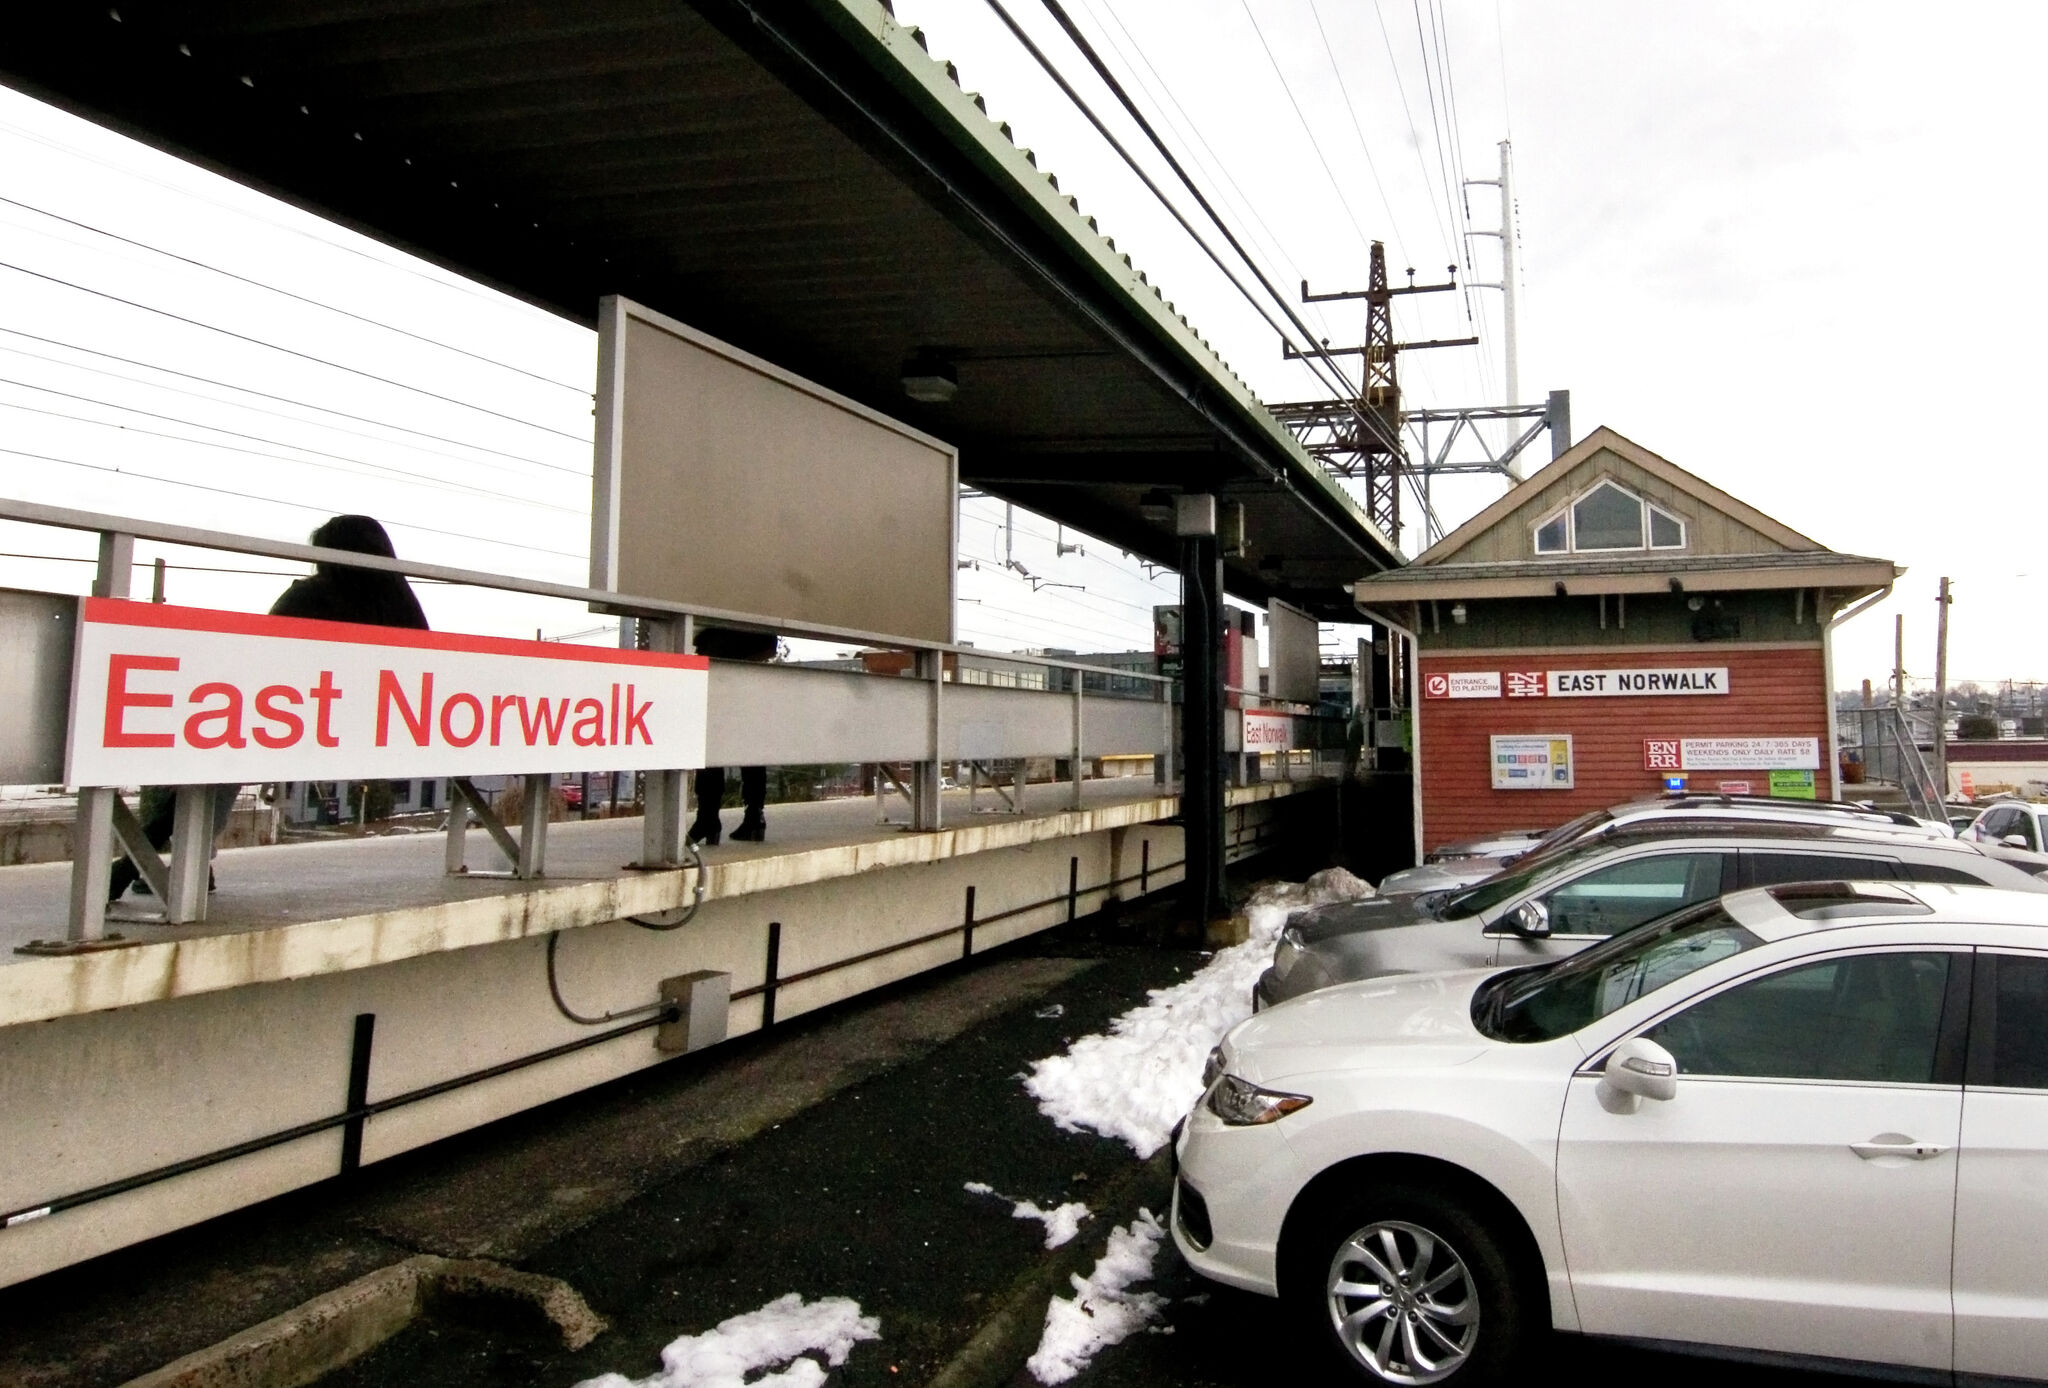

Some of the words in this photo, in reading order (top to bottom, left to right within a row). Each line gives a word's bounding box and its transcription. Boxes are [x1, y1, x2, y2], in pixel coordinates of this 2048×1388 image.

[1558, 675, 1606, 691] EAST
[1618, 673, 1717, 690] NORWALK
[103, 653, 343, 749] East
[375, 669, 654, 748] Norwalk
[1247, 722, 1262, 744] East
[1263, 722, 1288, 744] Norwalk
[1647, 742, 1678, 754] EN
[1648, 755, 1679, 767] RR
